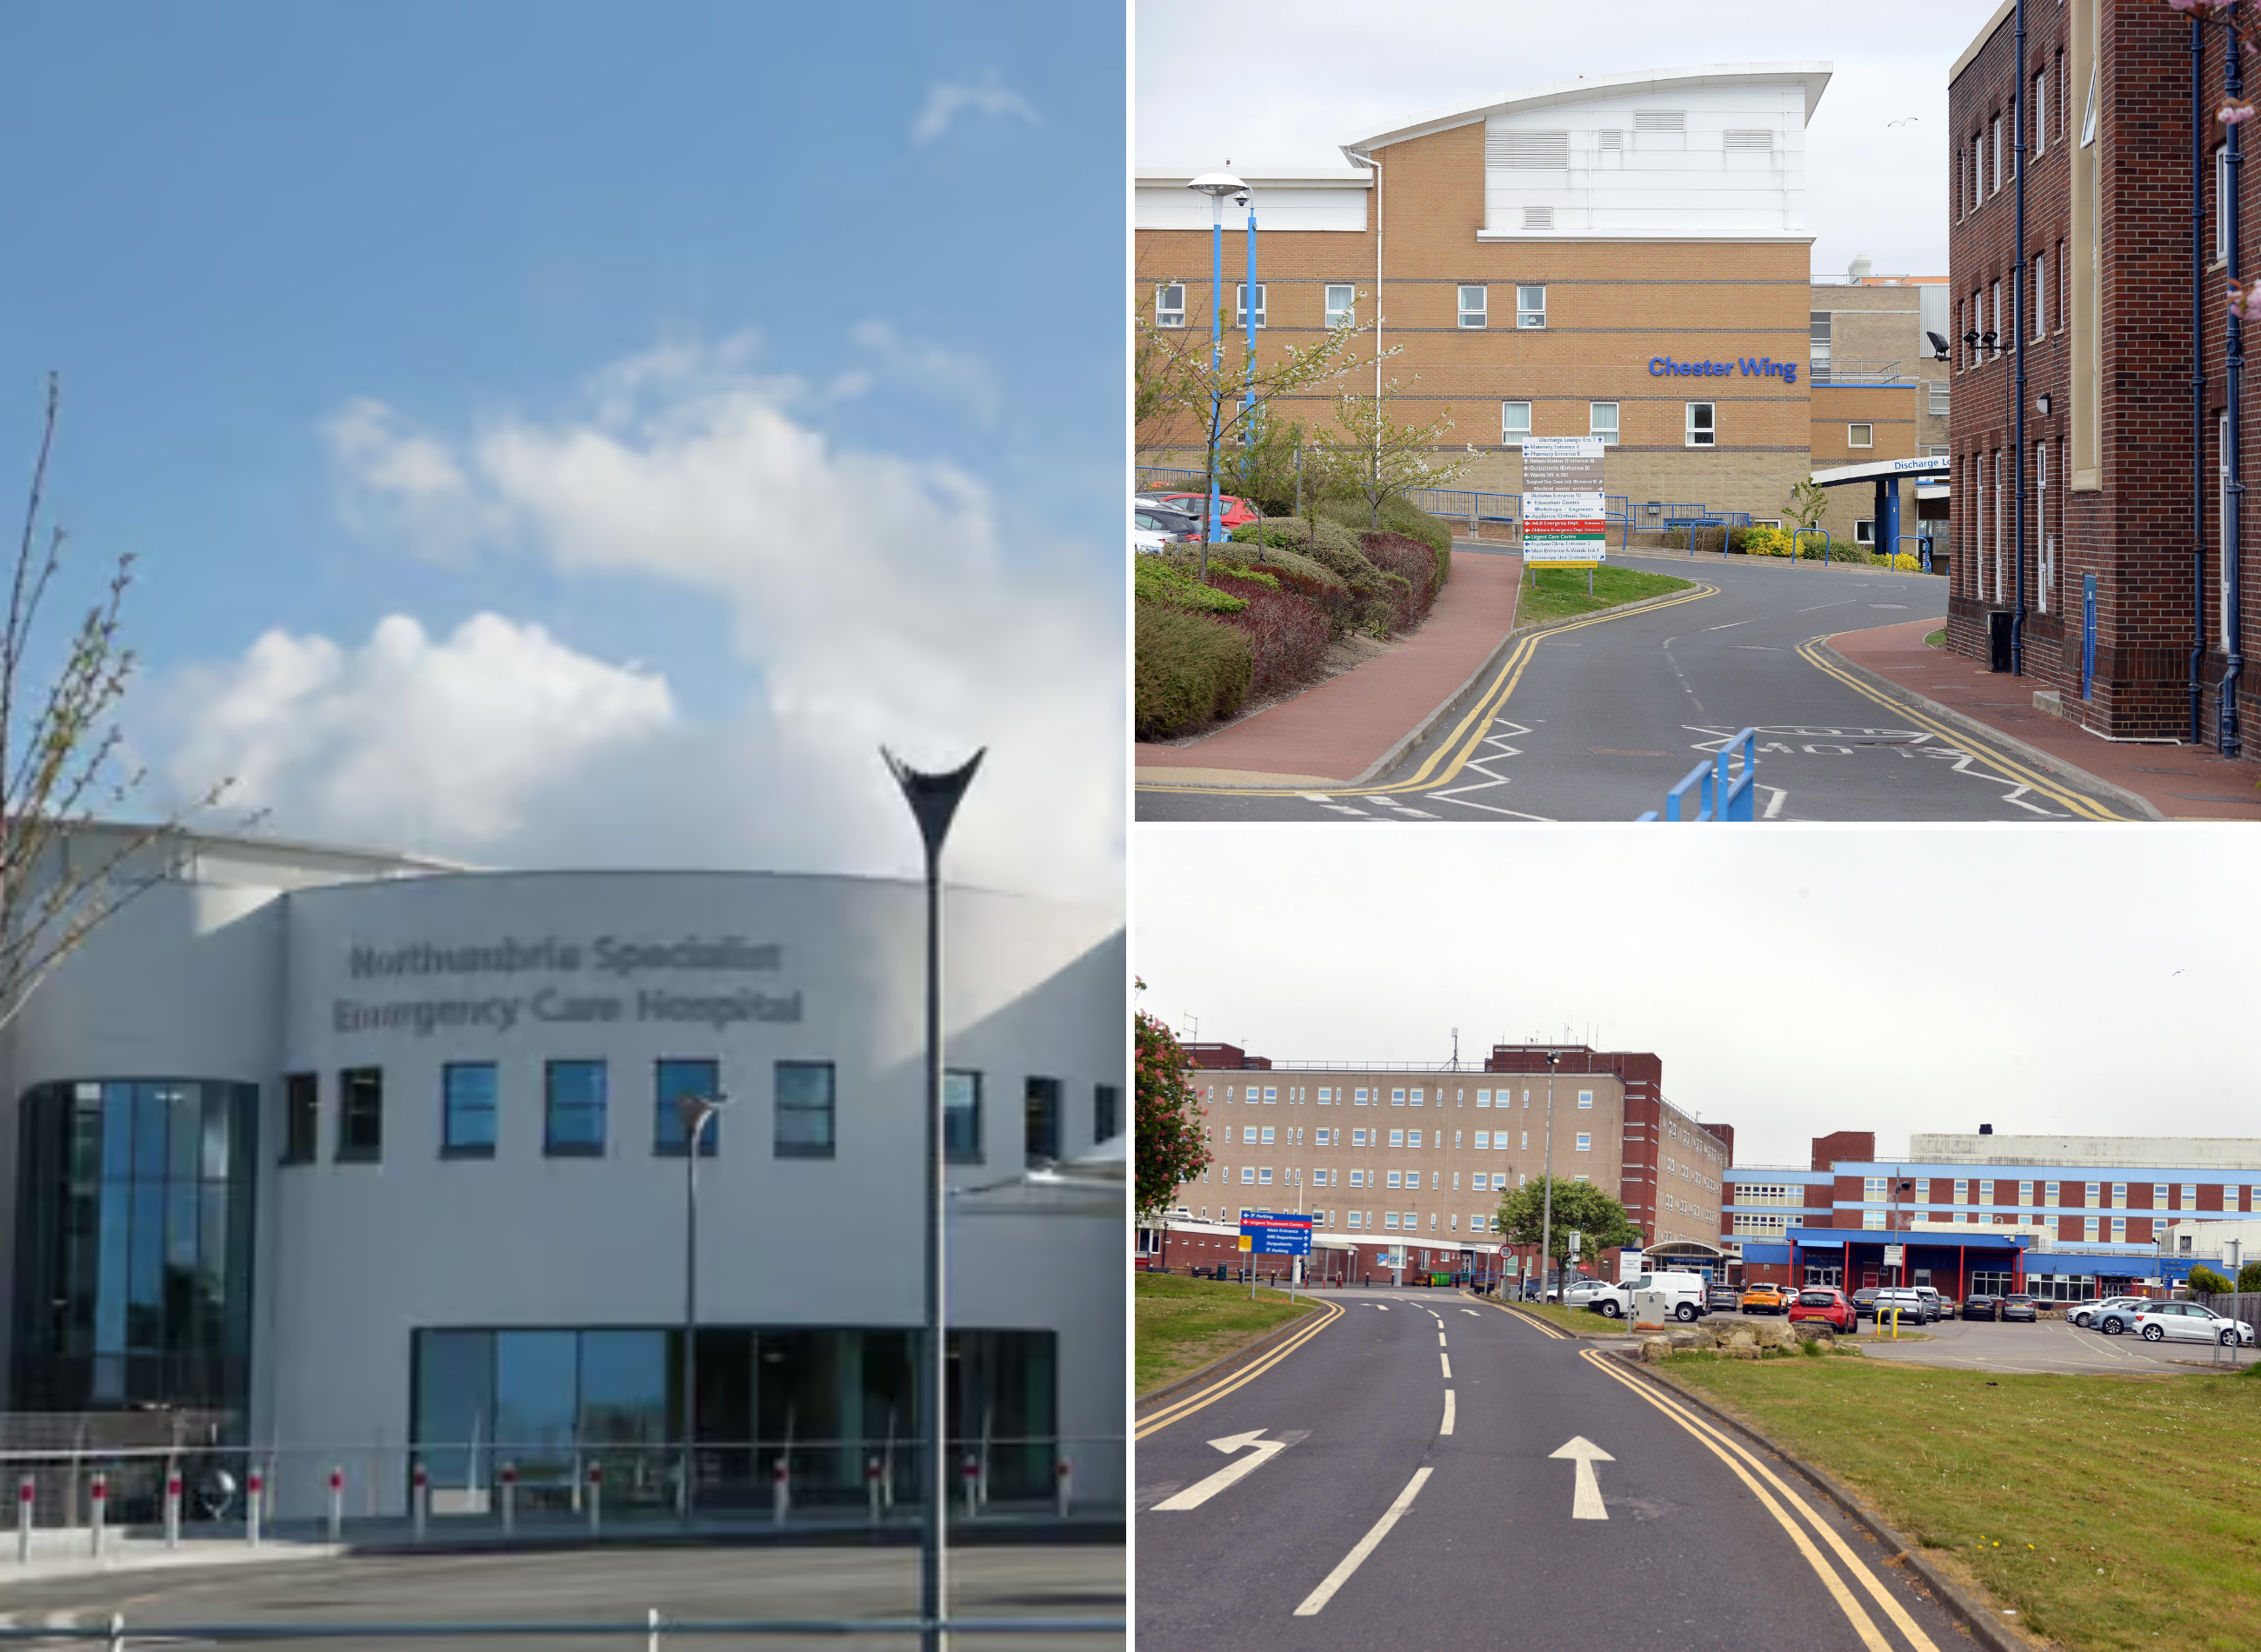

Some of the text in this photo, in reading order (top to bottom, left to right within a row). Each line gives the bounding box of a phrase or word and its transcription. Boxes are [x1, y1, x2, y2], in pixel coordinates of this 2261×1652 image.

[1649, 356, 1797, 382] Chester Wing
[1895, 460, 1939, 470] Discharge
[351, 936, 782, 978] Northumbria Specialist
[333, 988, 802, 1036] Emergency Care Hospital
